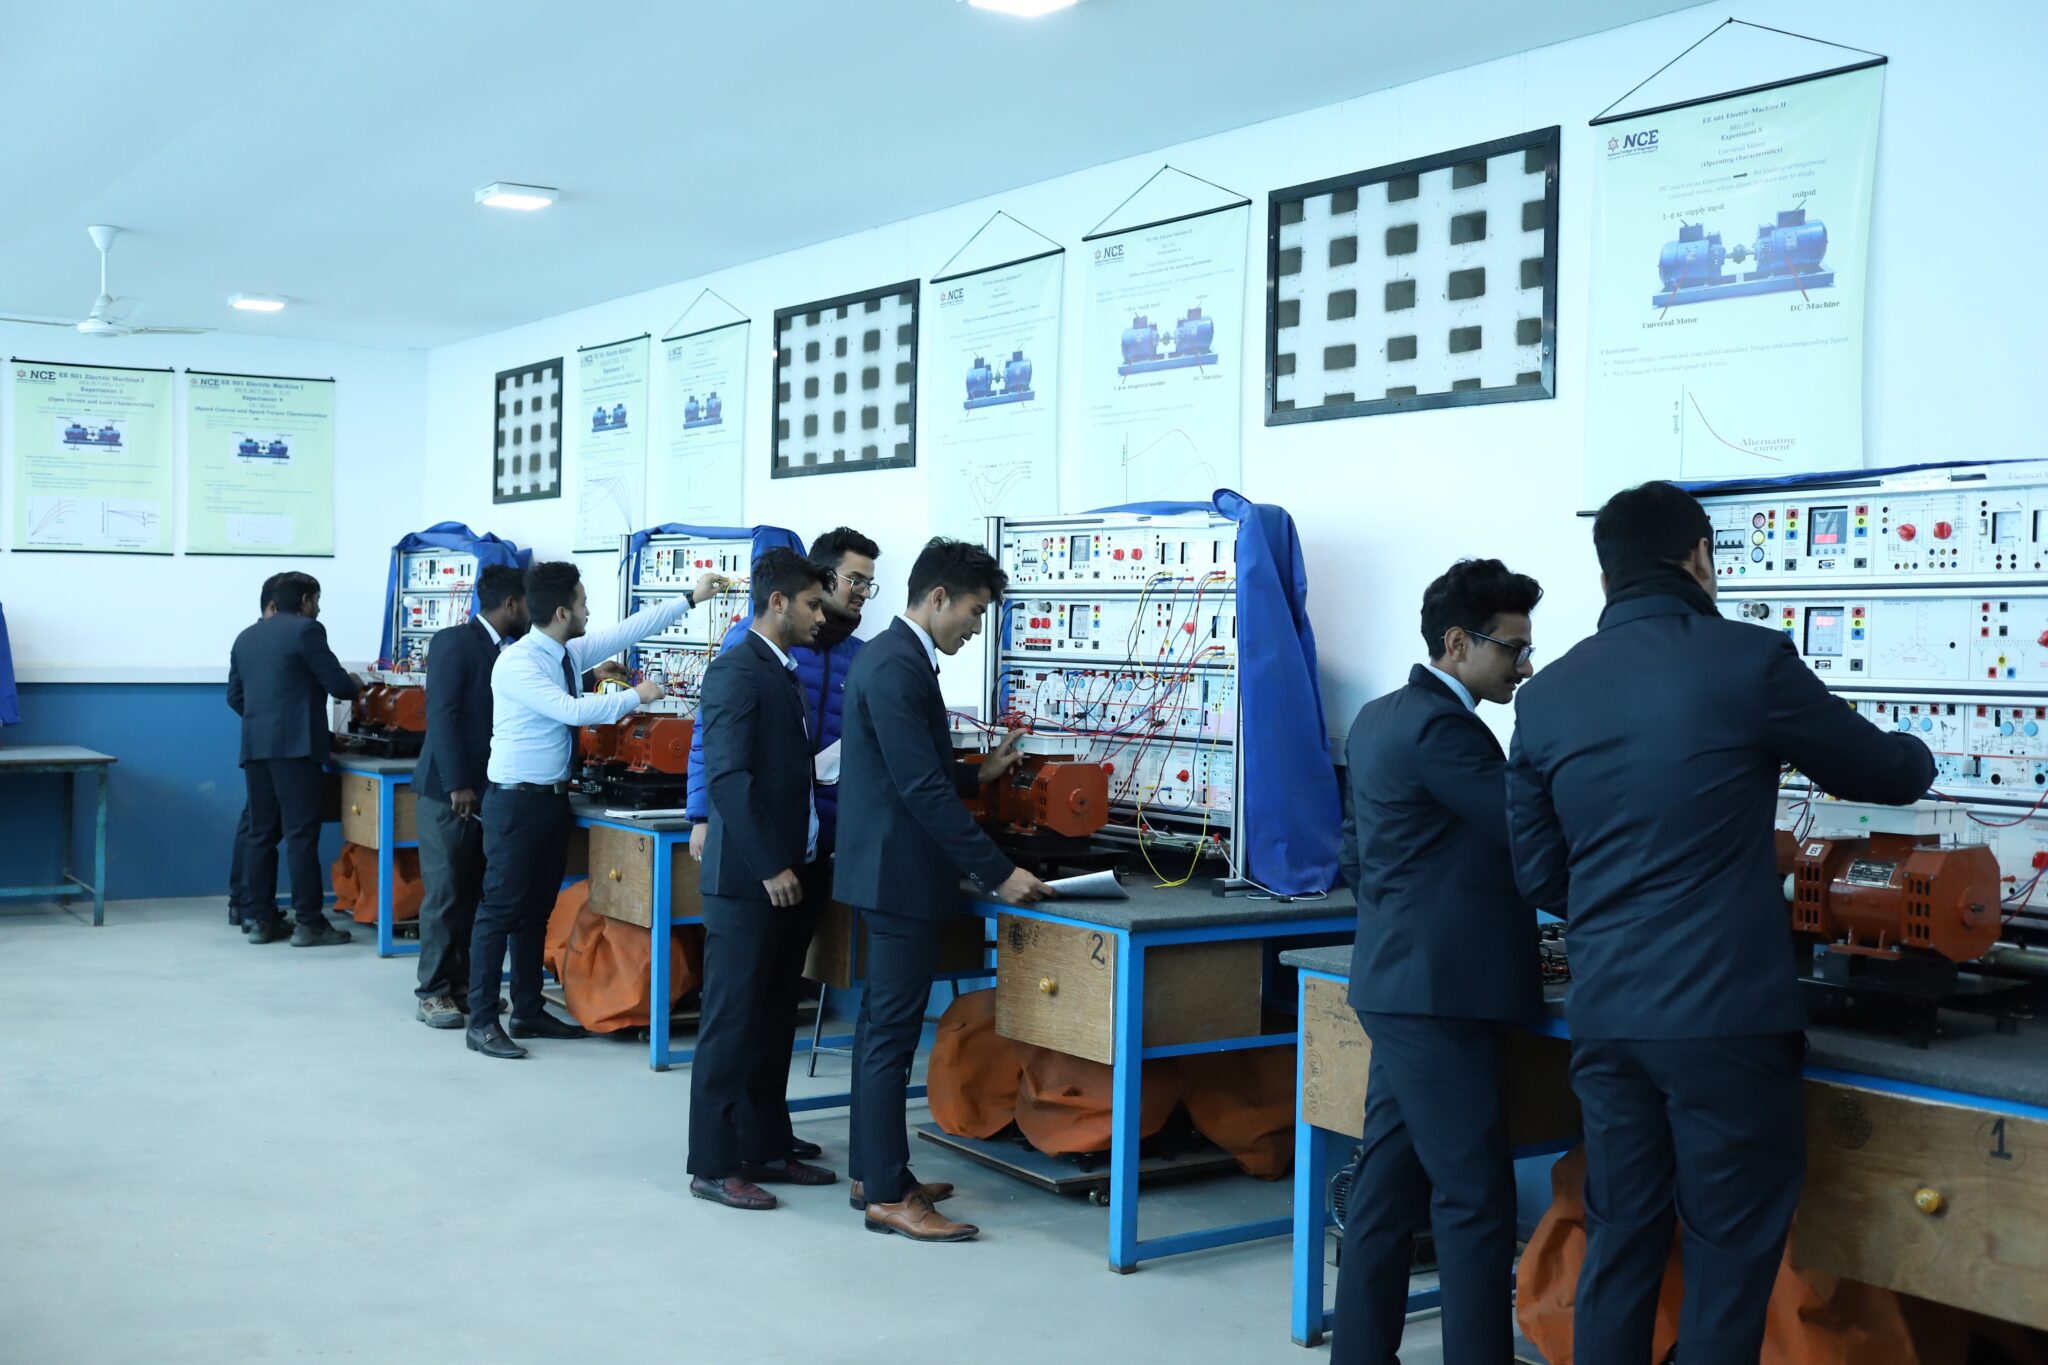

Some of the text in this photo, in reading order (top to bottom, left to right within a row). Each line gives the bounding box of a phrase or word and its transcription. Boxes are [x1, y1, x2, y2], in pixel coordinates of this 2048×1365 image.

[1751, 105, 1779, 114] Machine
[1623, 129, 1659, 149] NCE
[1721, 129, 1757, 141] Experiment
[1792, 189, 1817, 199] output
[1684, 207, 1707, 217] supply
[1707, 203, 1724, 214] input
[1103, 244, 1125, 259] NCE
[947, 288, 964, 301] NCE
[1790, 300, 1841, 312] DC Machine
[1642, 316, 1699, 329] Universal Motor
[30, 370, 57, 381] NCE
[200, 378, 220, 386] NCE
[1740, 437, 1796, 447] Alternating
[638, 837, 645, 853] 3
[1090, 932, 1105, 965] 2
[1990, 1118, 2013, 1160] 1
